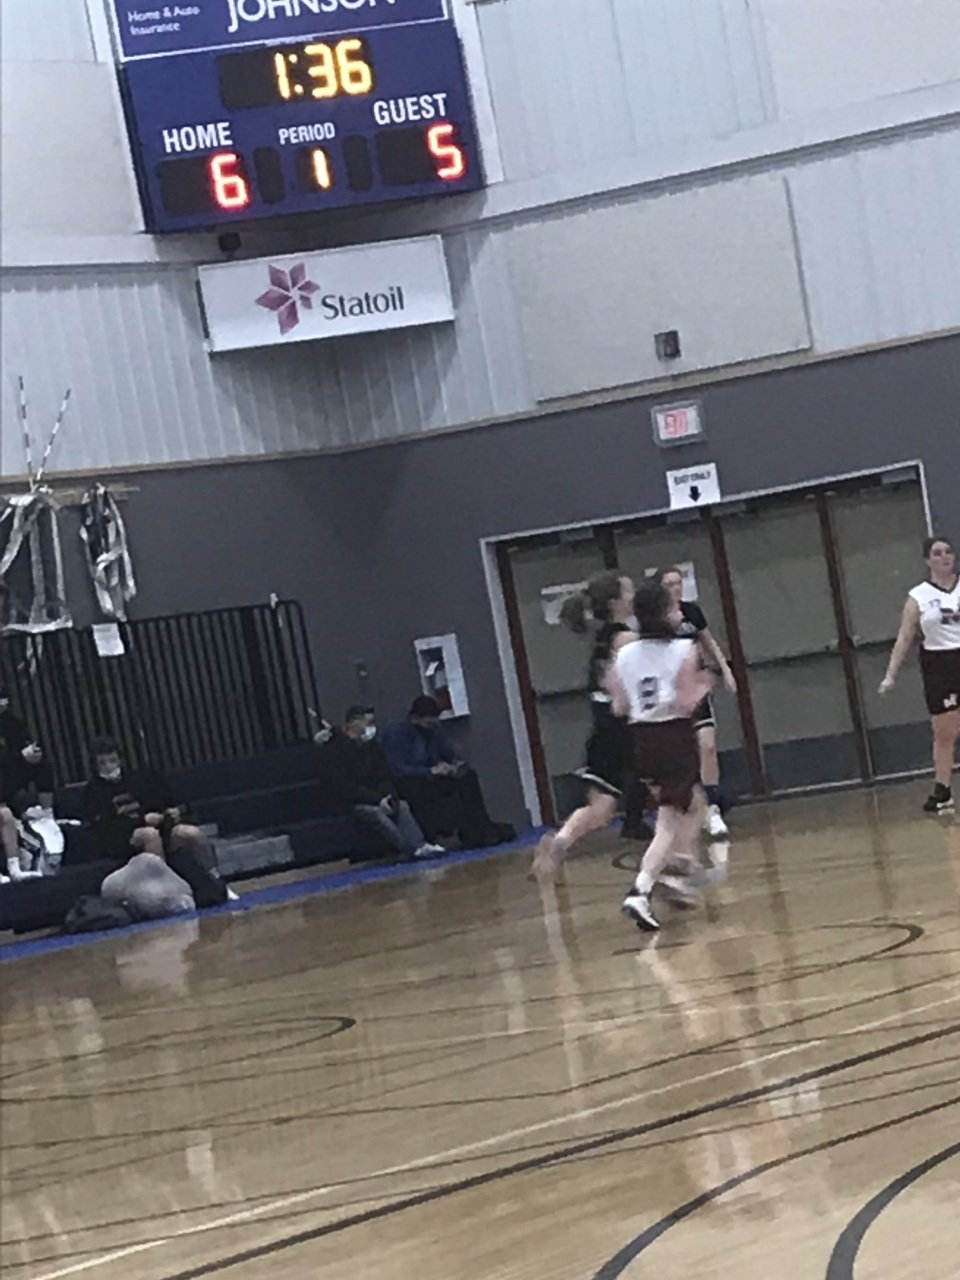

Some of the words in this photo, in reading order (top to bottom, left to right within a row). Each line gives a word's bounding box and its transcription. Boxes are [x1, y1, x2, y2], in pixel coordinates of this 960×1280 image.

[227, 0, 395, 33] JOHN
[274, 38, 373, 99] 1:36
[373, 93, 448, 126] GUEST
[162, 122, 234, 153] HOME
[278, 121, 336, 146] PERIOD
[426, 123, 465, 179] 5
[210, 152, 249, 209] 6
[312, 148, 331, 189] 1
[320, 286, 405, 321] Statoil
